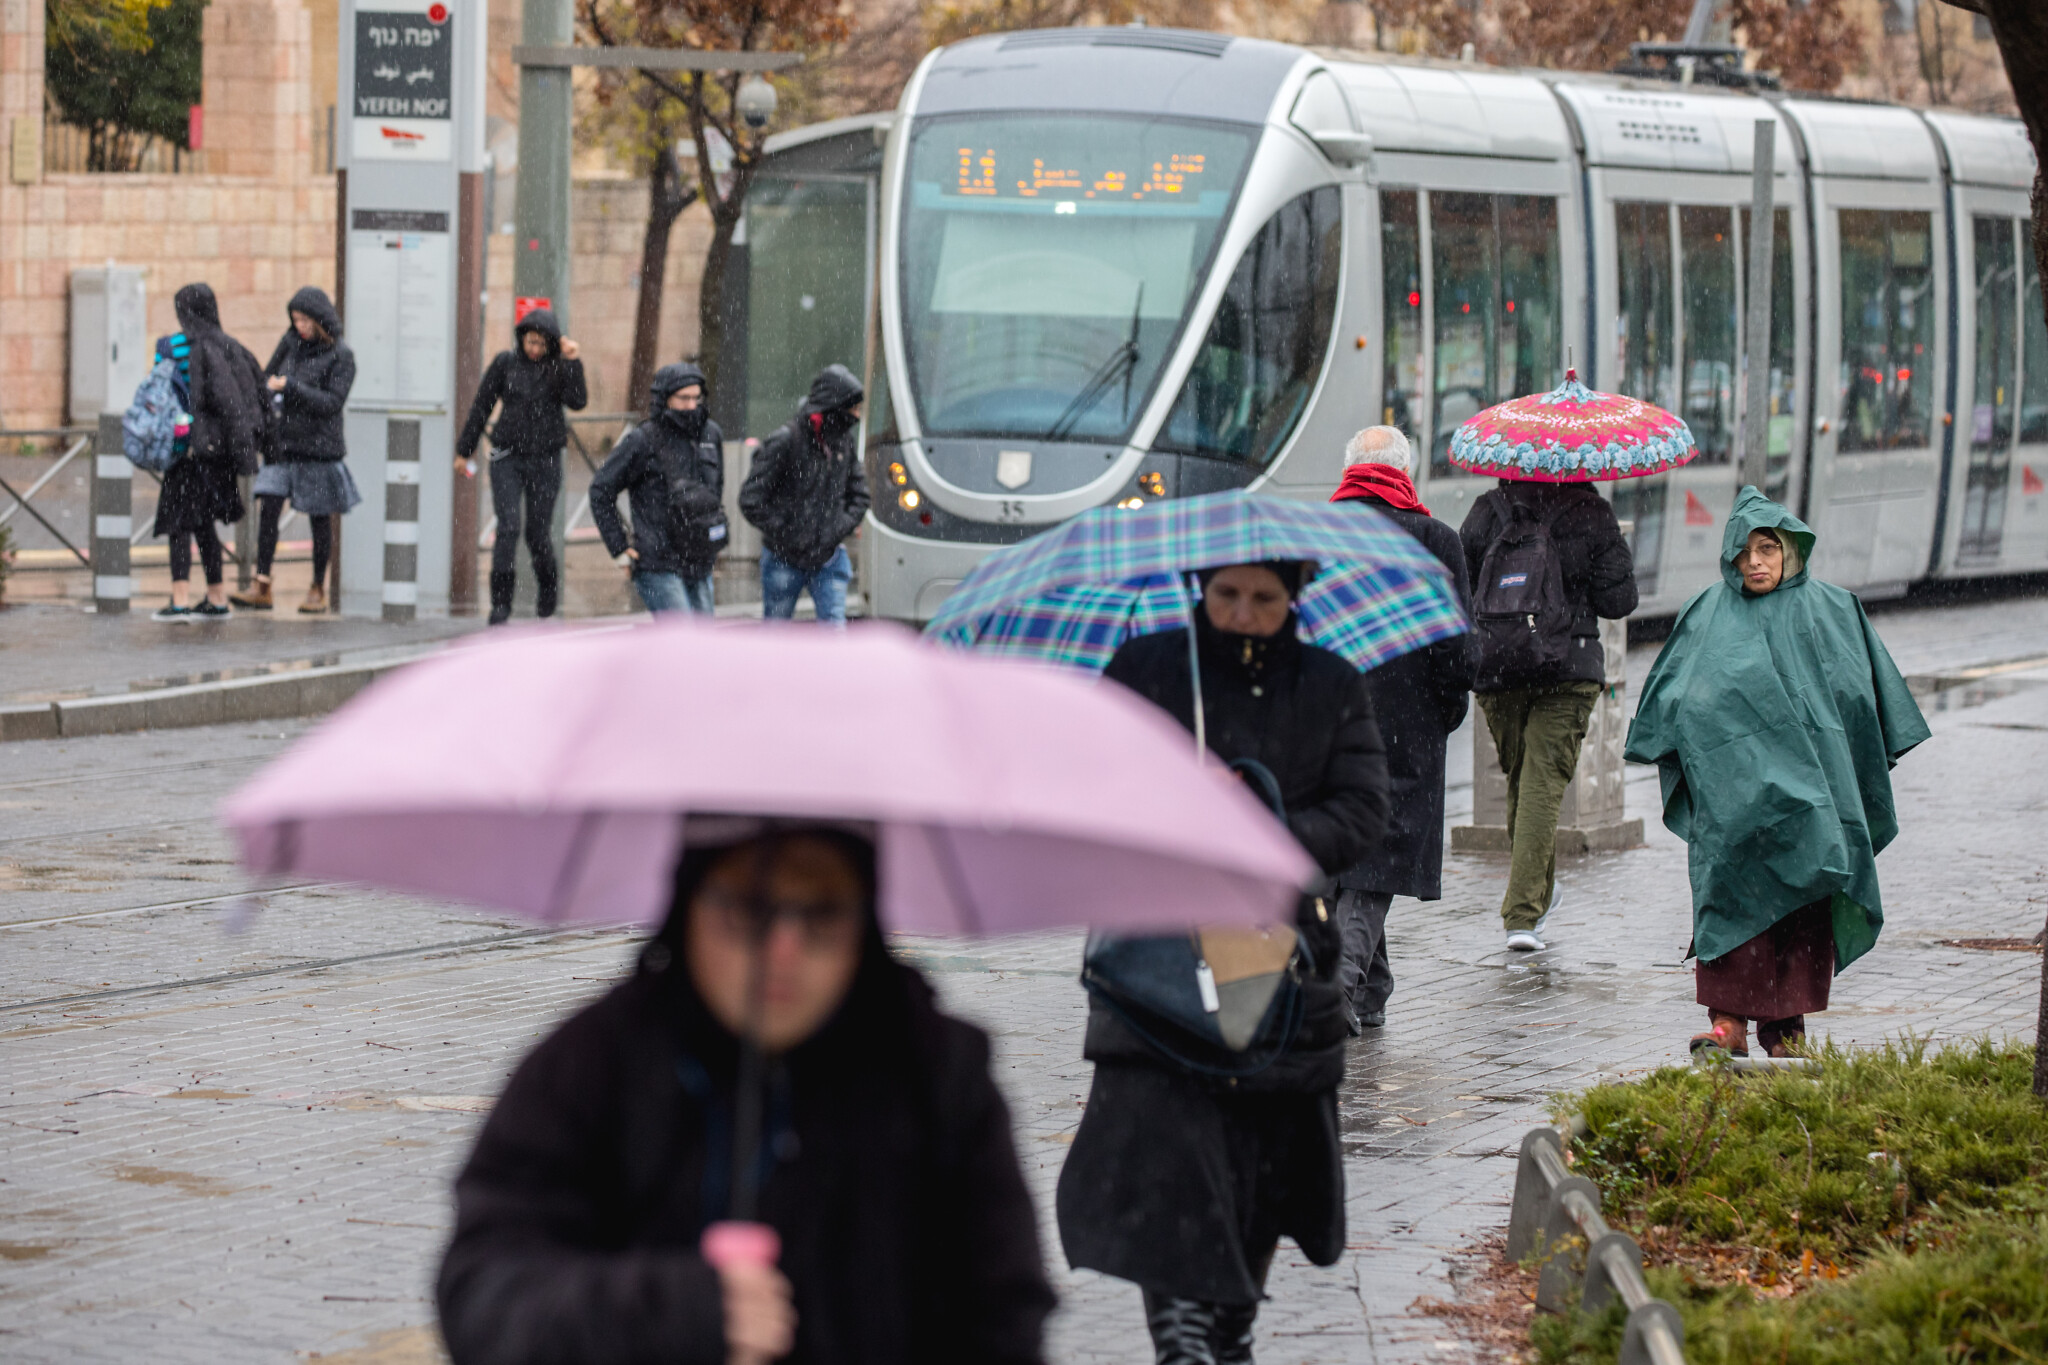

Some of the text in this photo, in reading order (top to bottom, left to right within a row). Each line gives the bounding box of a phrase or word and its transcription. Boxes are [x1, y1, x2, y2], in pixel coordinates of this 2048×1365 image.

[369, 26, 440, 48] יפה נוף
[359, 97, 448, 116] YEFEH NOF
